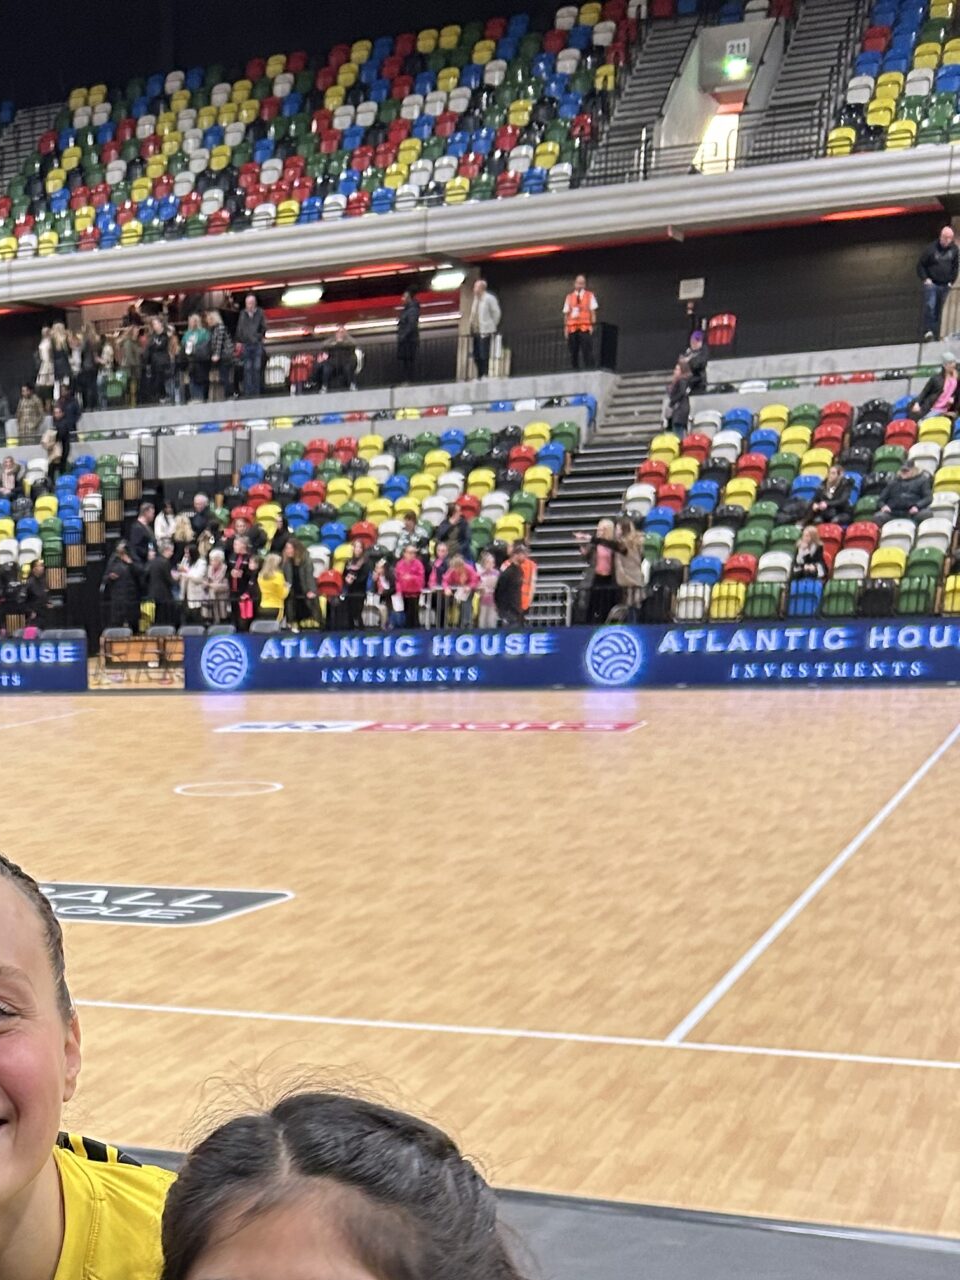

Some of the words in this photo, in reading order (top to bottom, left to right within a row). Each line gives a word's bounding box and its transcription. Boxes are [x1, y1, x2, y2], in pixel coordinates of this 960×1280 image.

[728, 42, 746, 55] 211
[260, 637, 418, 659] ATLANTIC
[431, 633, 552, 656] HOUSE
[657, 629, 848, 653] ATLANTIC
[869, 625, 960, 649] HOU
[320, 667, 479, 683] INVESTMENTS
[730, 661, 922, 679] INVESTMENTS
